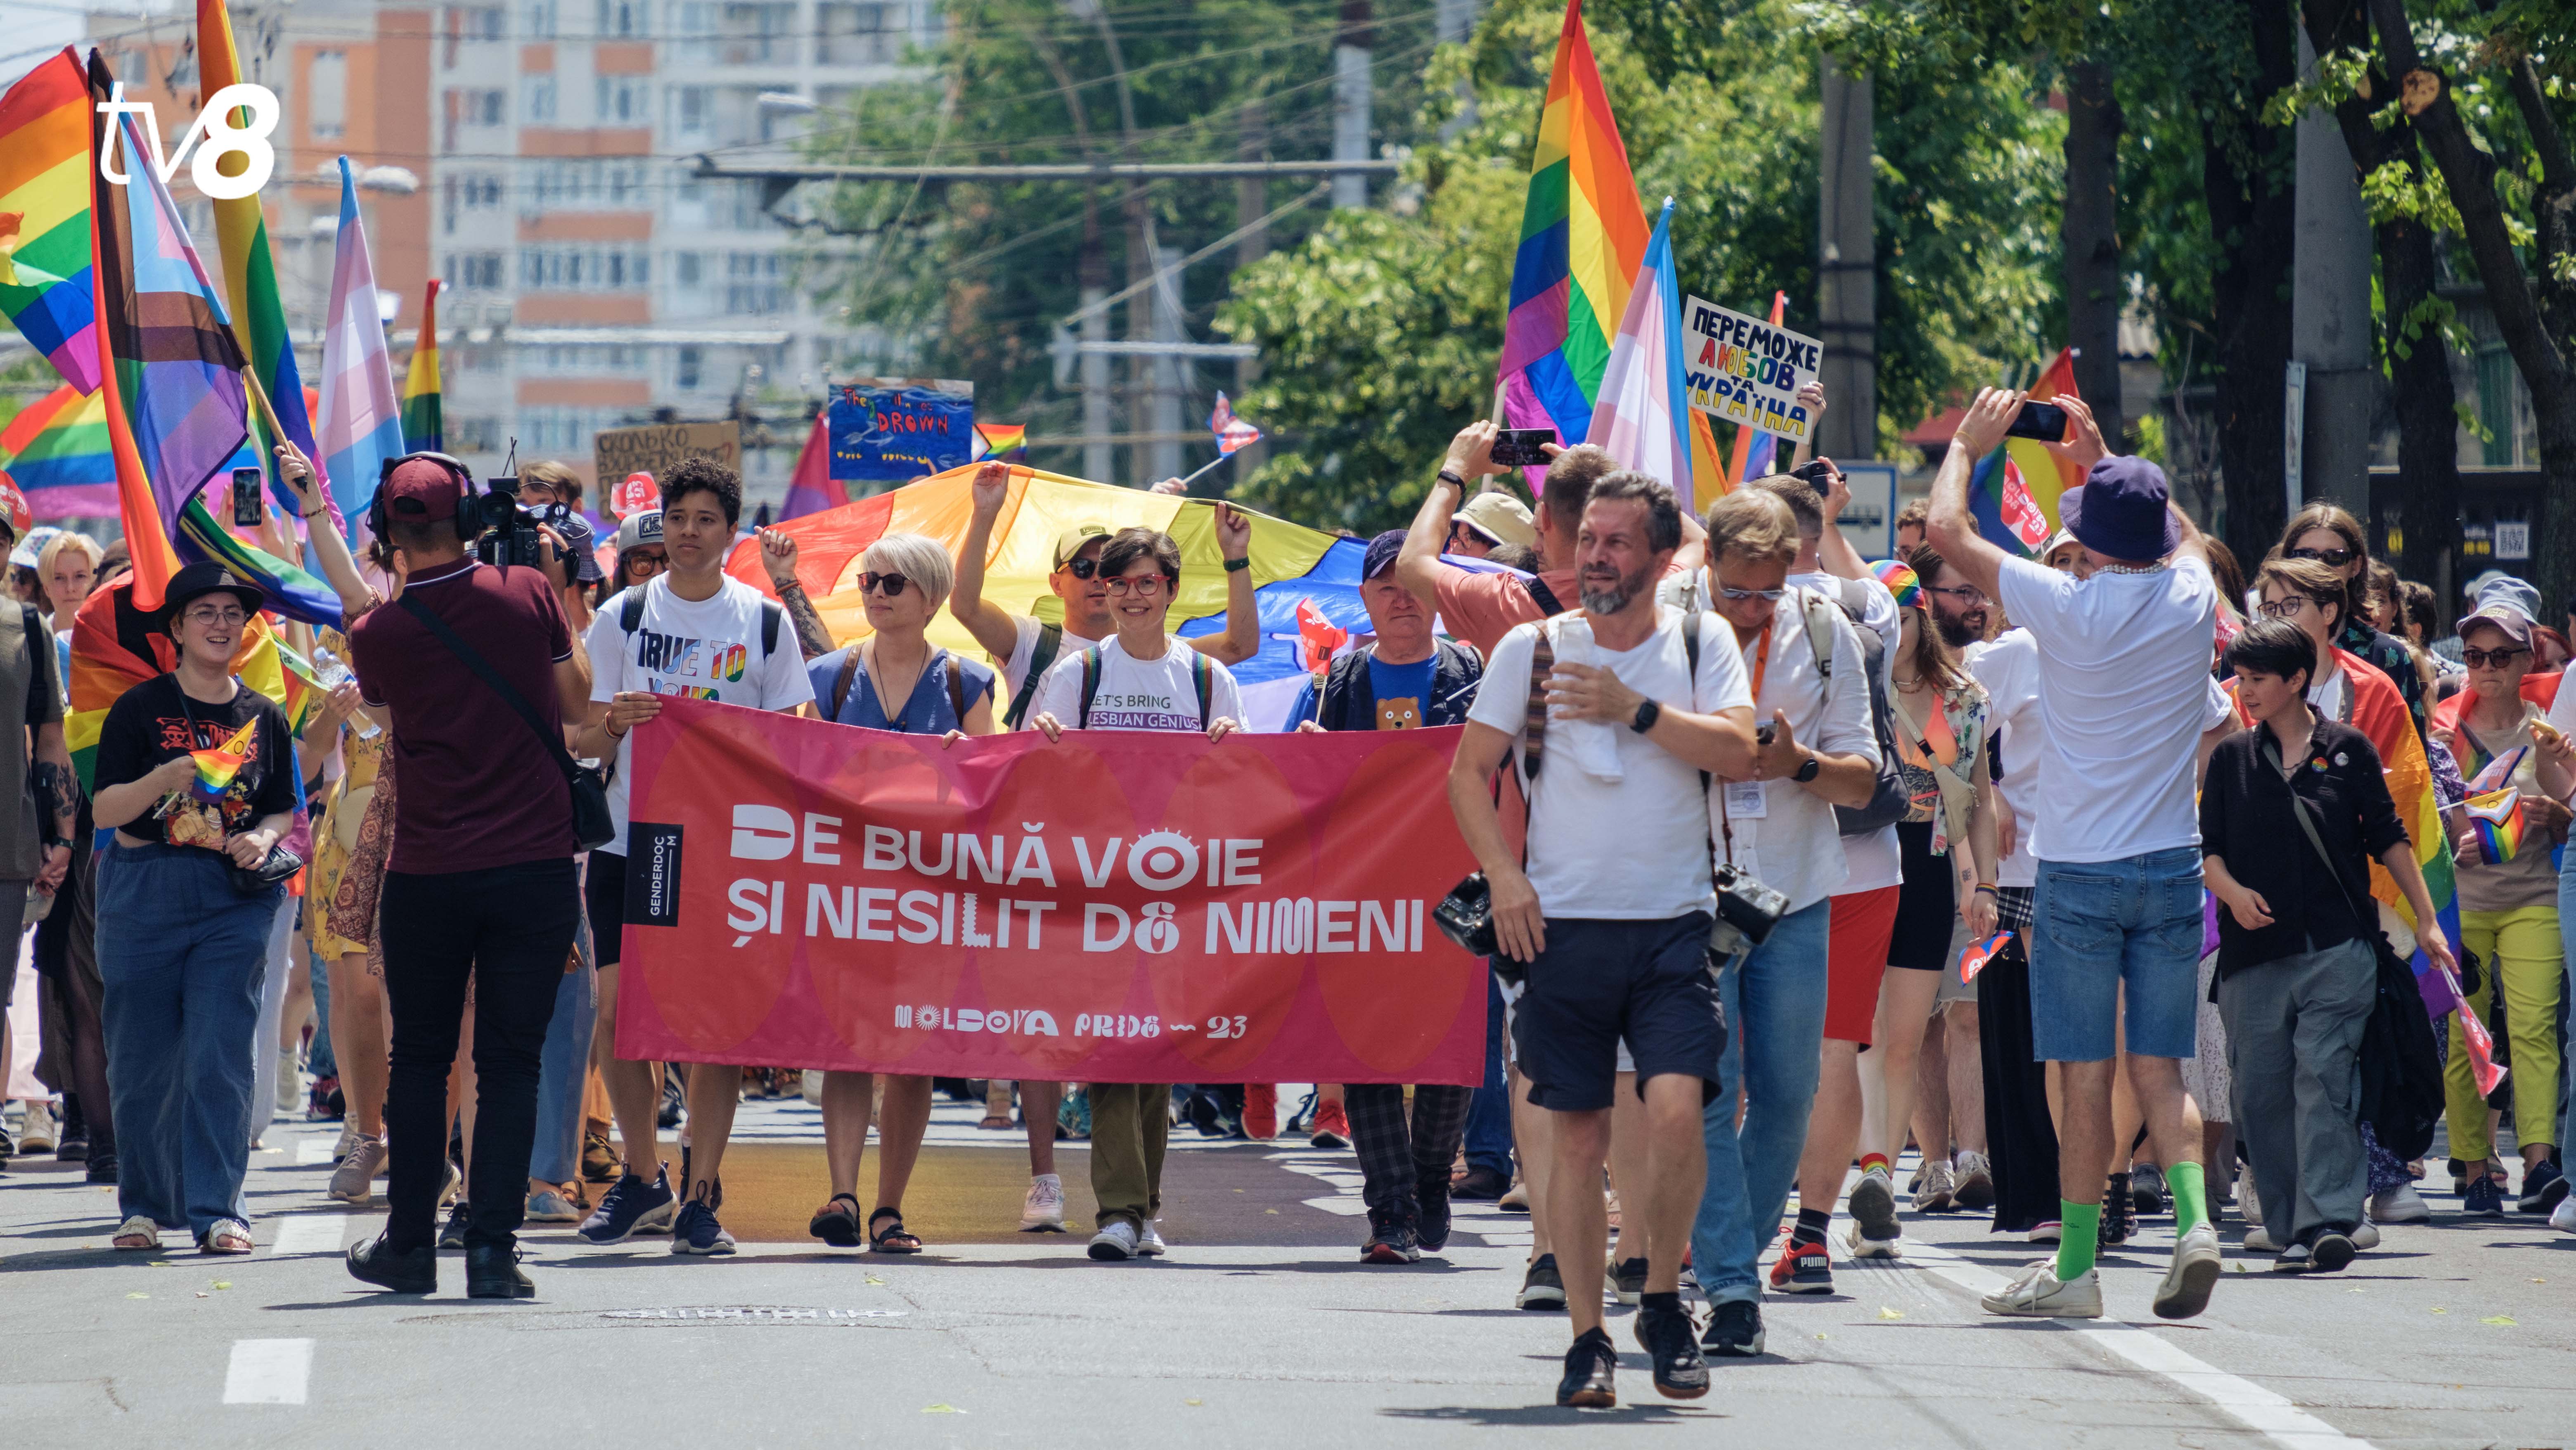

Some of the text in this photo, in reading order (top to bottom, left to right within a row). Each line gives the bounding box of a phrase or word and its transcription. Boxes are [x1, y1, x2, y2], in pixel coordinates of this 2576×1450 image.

[1693, 306, 1818, 373] ПЕРЕМОЖЕ
[1698, 338, 1795, 391] ЛЮБОВ
[1685, 368, 1807, 436] УКРАЇНА
[1731, 375, 1754, 392] ТА
[876, 412, 948, 436] DROWN
[637, 628, 746, 682] TRUE TO
[1088, 712, 1199, 730] LESBIAN GENIUS
[1091, 694, 1171, 709] ET'S BRING
[730, 804, 1264, 891] DE BUNĂ VOIE
[650, 836, 665, 916] GENDERDOC
[805, 884, 1057, 950] NESILIT
[1205, 897, 1424, 955] NIMENI
[895, 1004, 1059, 1037] MOLDOVA
[1207, 1015, 1248, 1039] 23
